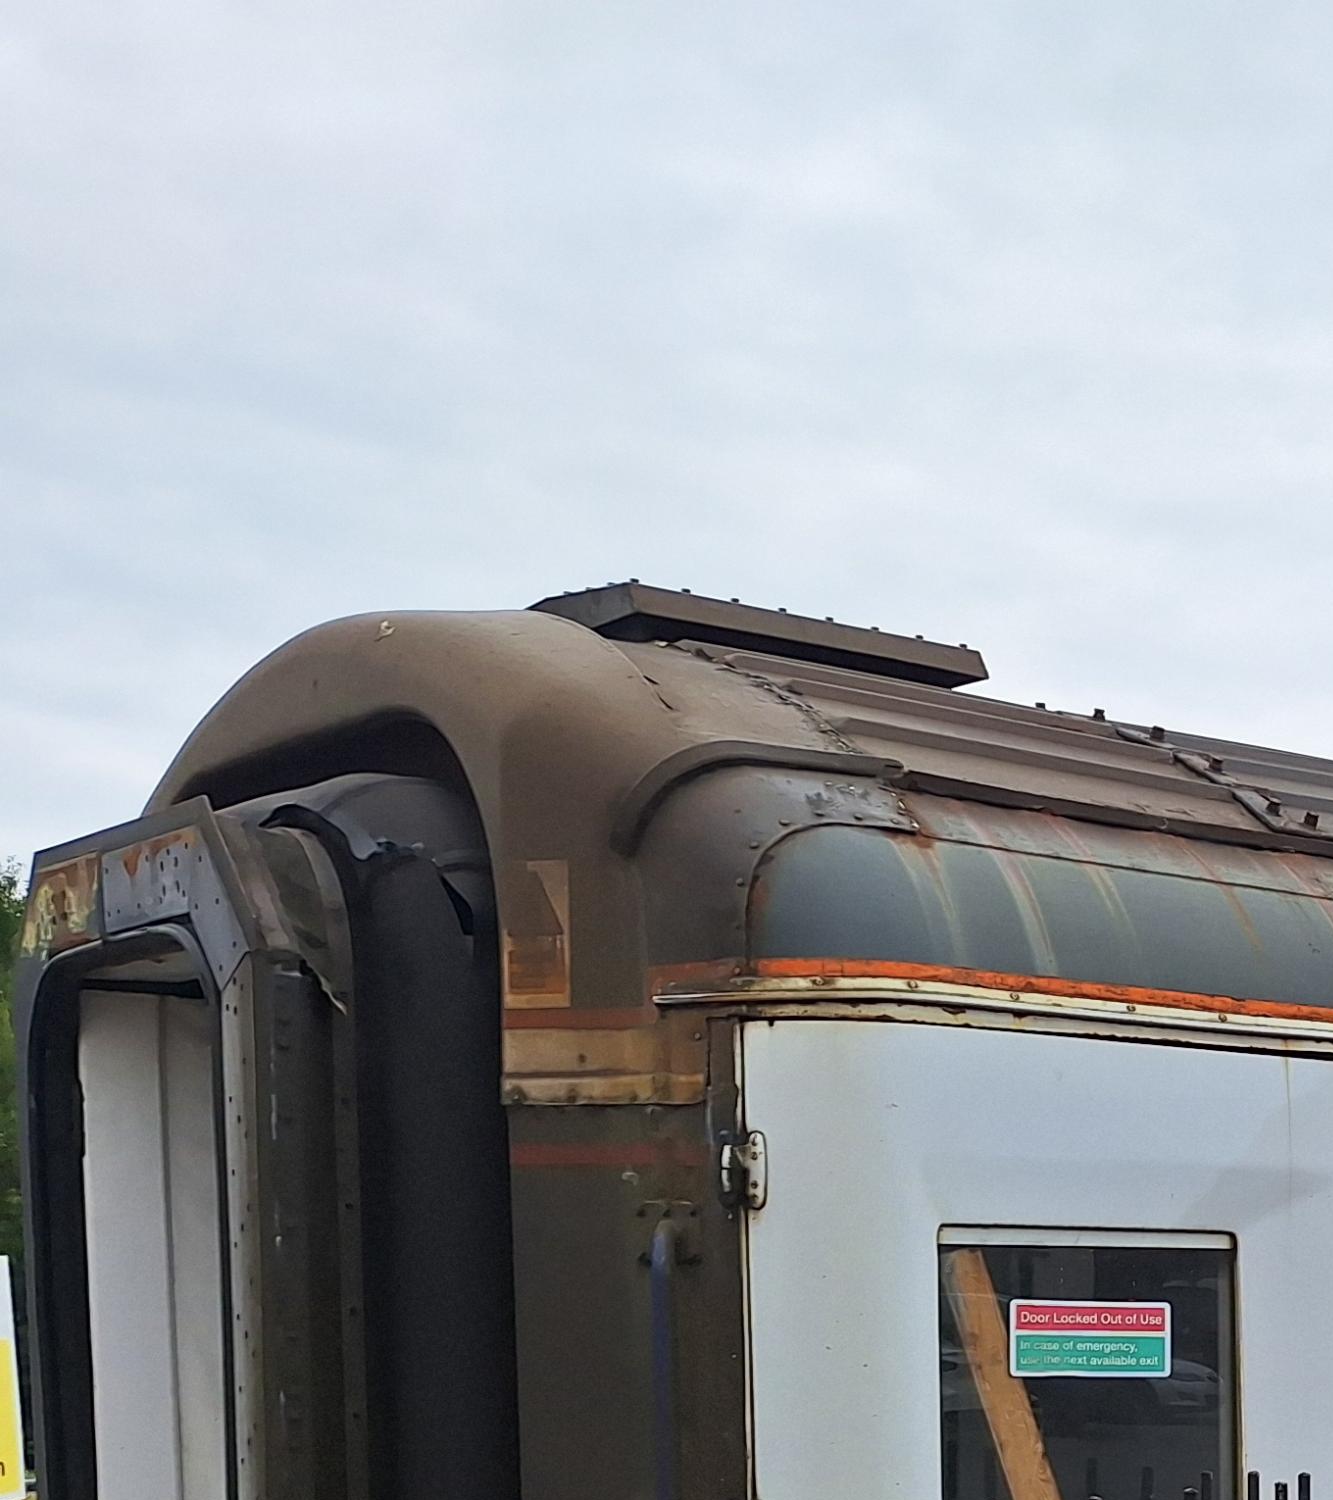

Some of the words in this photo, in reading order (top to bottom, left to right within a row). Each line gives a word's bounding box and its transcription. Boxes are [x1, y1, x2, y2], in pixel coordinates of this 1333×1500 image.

[1020, 1311, 1051, 1324] Door
[1053, 1311, 1098, 1325] Locked
[1100, 1313, 1122, 1325] Out
[1125, 1314, 1137, 1325] of
[1140, 1314, 1163, 1326] Use
[1020, 1341, 1031, 1350] In
[1033, 1342, 1060, 1351] case
[1062, 1341, 1074, 1351] of
[1076, 1342, 1139, 1354] emergency,
[1043, 1354, 1061, 1365] the
[1063, 1355, 1088, 1365] next
[1089, 1355, 1137, 1366] available
[1139, 1355, 1159, 1367] exit
